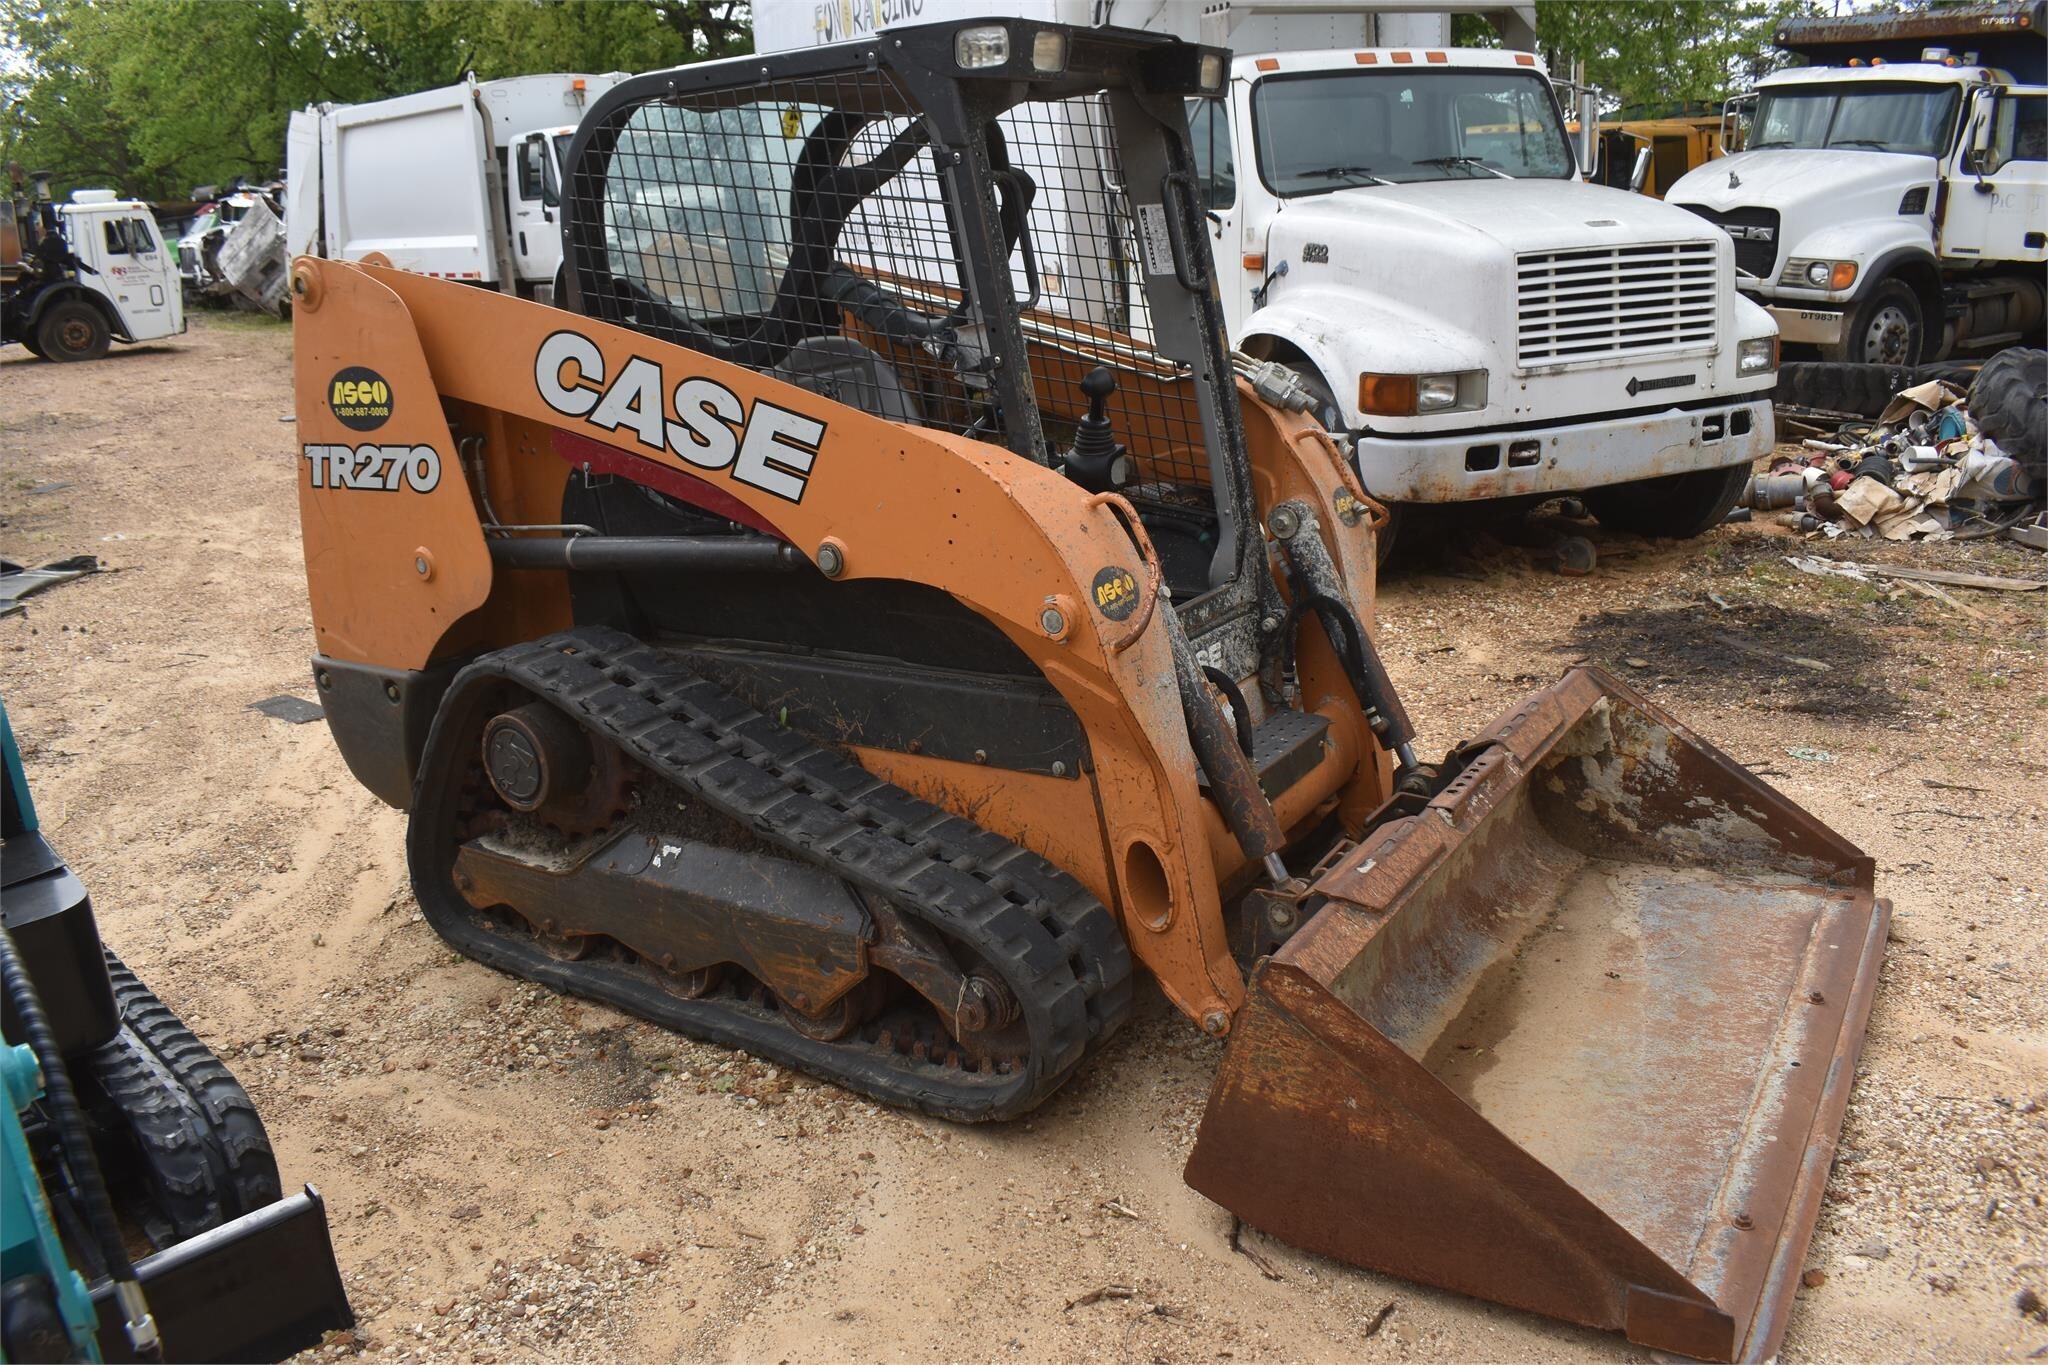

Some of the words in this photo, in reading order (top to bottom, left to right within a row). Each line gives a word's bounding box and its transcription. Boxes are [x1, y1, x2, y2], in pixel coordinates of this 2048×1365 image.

[1800, 311, 1839, 321] DT9831
[333, 380, 388, 405] ASCO
[534, 329, 828, 506] CASE
[303, 442, 442, 494] TR270
